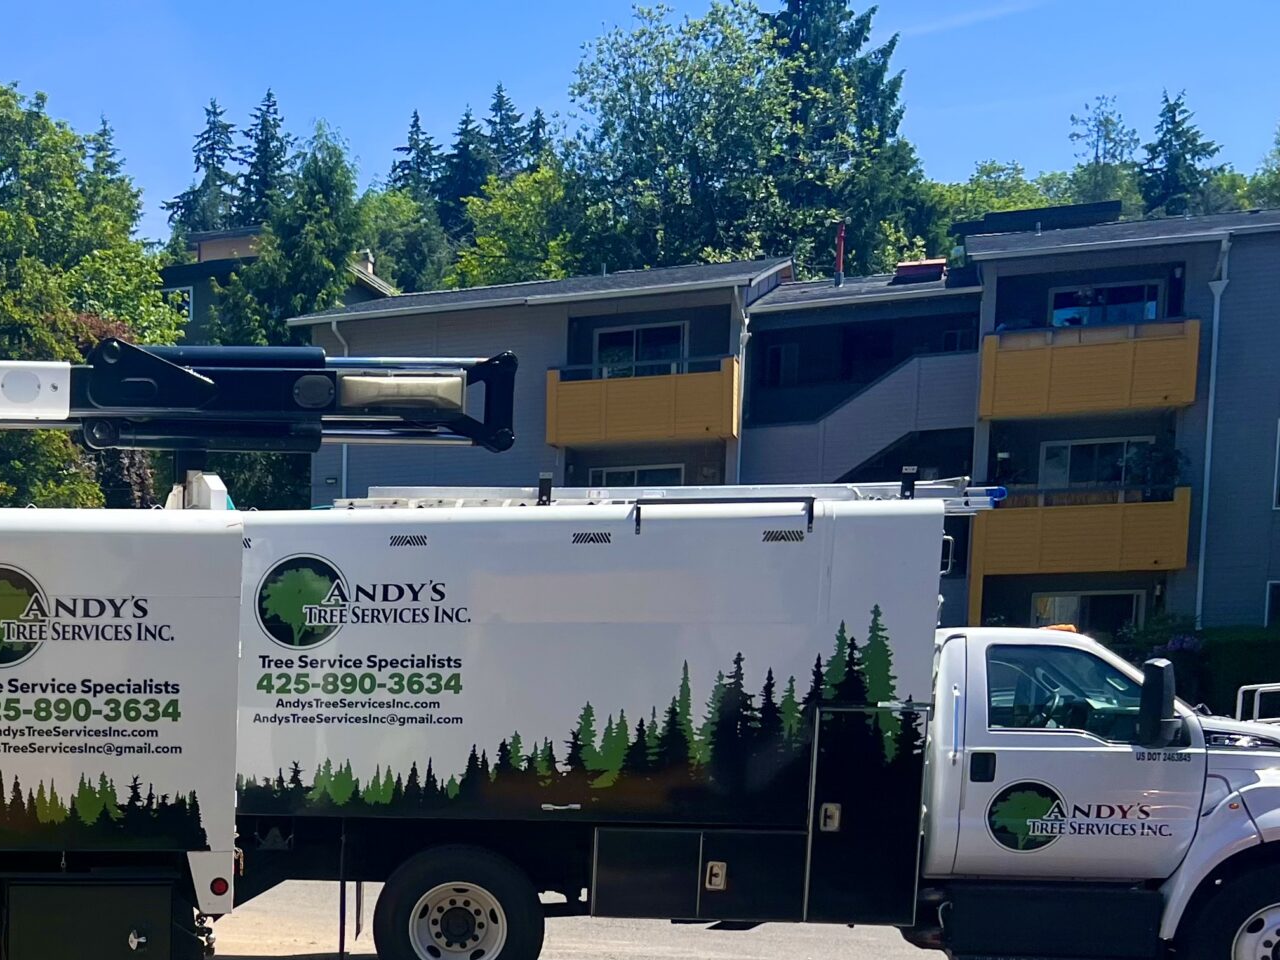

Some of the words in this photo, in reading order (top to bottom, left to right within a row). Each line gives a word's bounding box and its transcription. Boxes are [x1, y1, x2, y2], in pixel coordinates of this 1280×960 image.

[326, 579, 447, 603] ANDY'S
[22, 594, 149, 619] ANDY'S
[304, 606, 347, 624] TREE
[351, 606, 430, 624] SERVICES
[434, 606, 472, 624] INC.
[2, 621, 47, 641] TREE
[51, 622, 132, 642] SERVICES
[136, 623, 175, 642] INC.
[258, 655, 294, 669] Tree
[298, 655, 363, 669] Service
[366, 655, 462, 672] Specialists
[7, 678, 77, 695] Service
[80, 678, 181, 697] Specialists
[256, 672, 463, 695] 425-890-3634
[275, 698, 441, 710] AndysTreeServicesInc.com
[253, 713, 464, 726] AndysTreeServicesInc@gmail.com
[1135, 751, 1146, 761] US
[1147, 751, 1161, 761] DOT
[1046, 801, 1151, 820] ANDY'S
[1029, 820, 1066, 835] TREE
[1069, 821, 1137, 836] SERVICES
[1139, 822, 1173, 837] INC.
